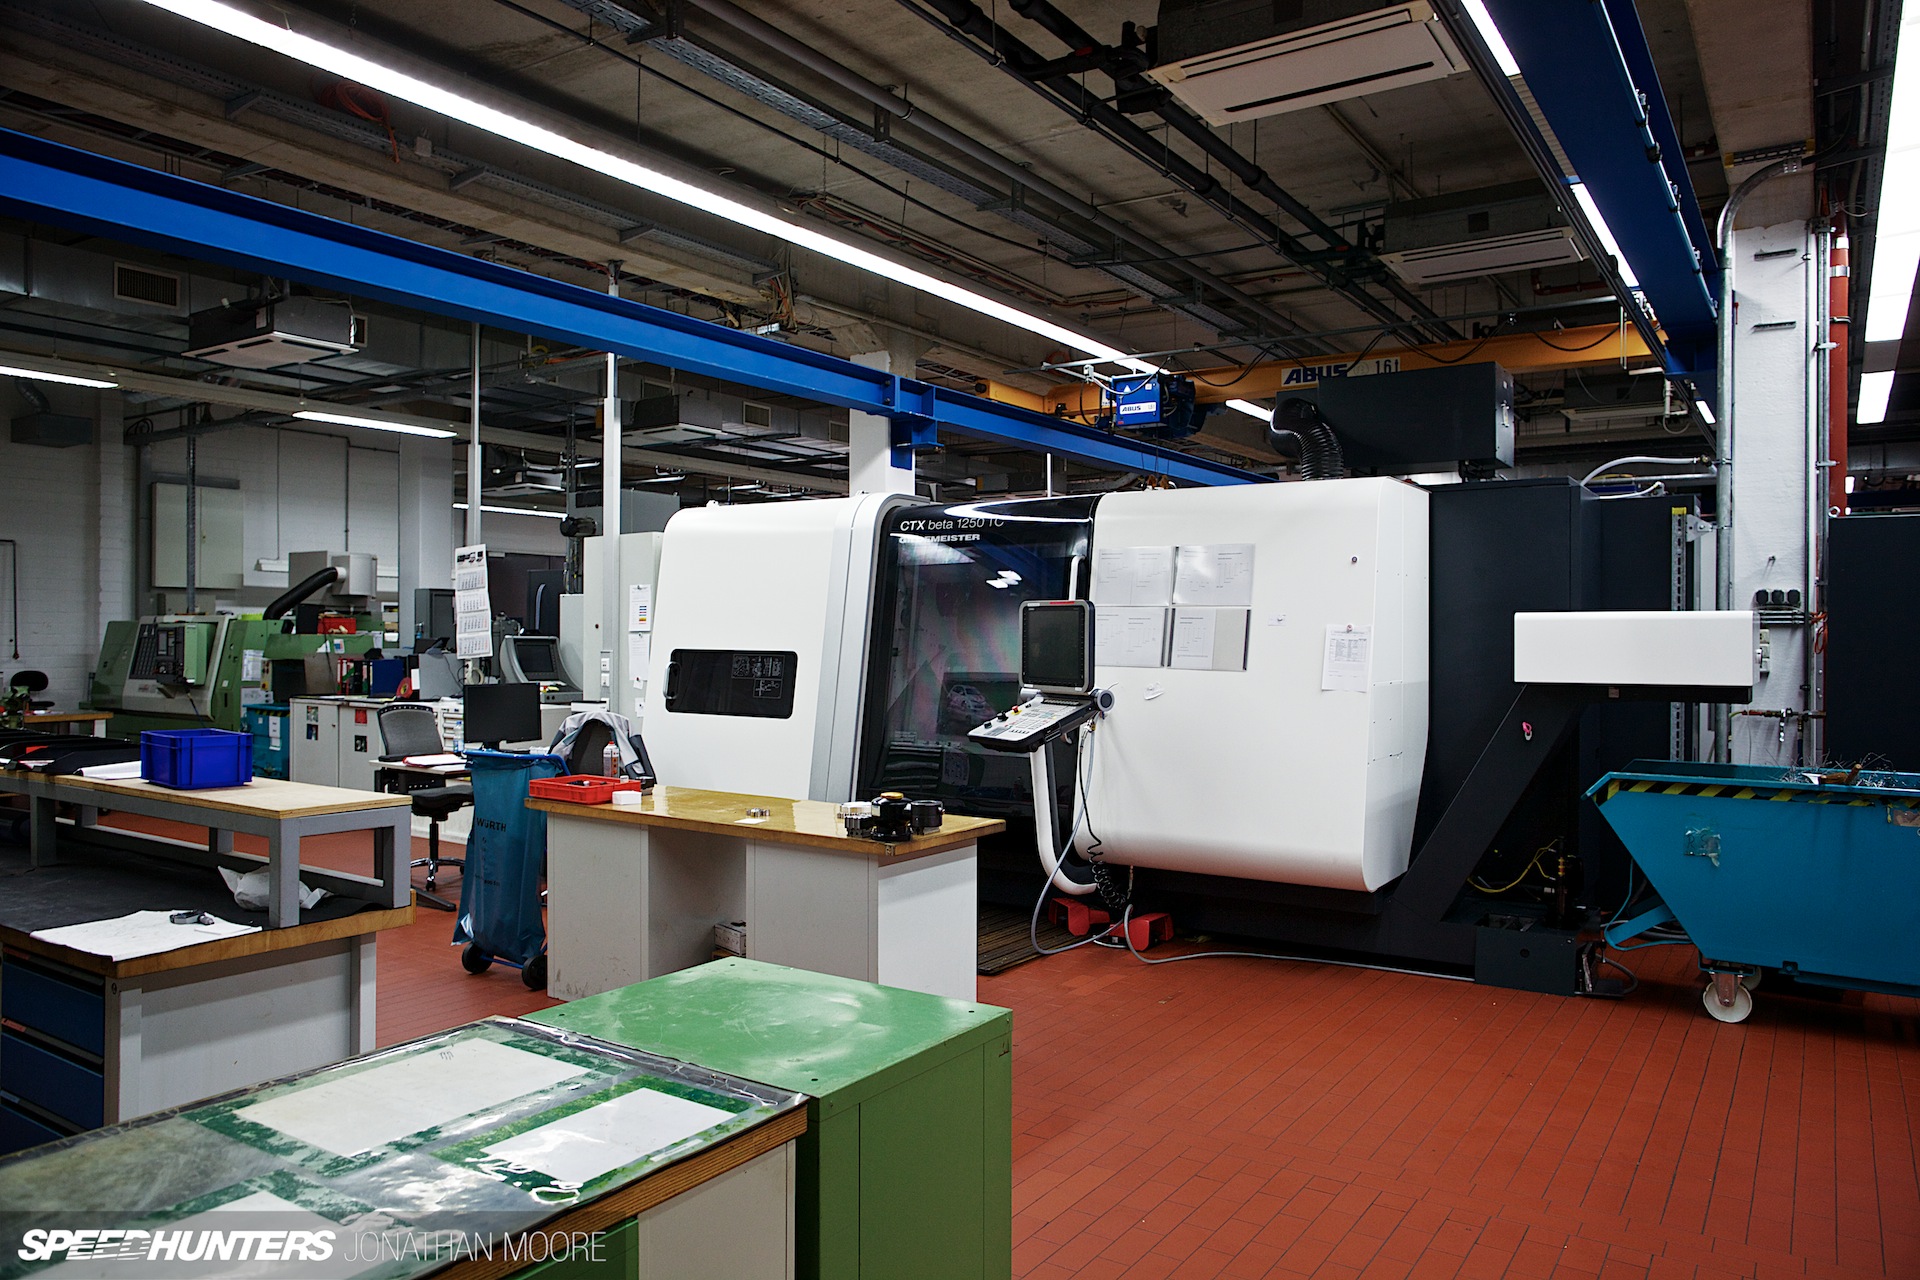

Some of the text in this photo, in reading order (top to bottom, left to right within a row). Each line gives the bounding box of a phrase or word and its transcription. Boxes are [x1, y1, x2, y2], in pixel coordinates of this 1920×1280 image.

[1283, 364, 1348, 385] ABUS
[900, 520, 926, 531] CTX
[927, 519, 953, 530] beta
[957, 518, 985, 529] 1250
